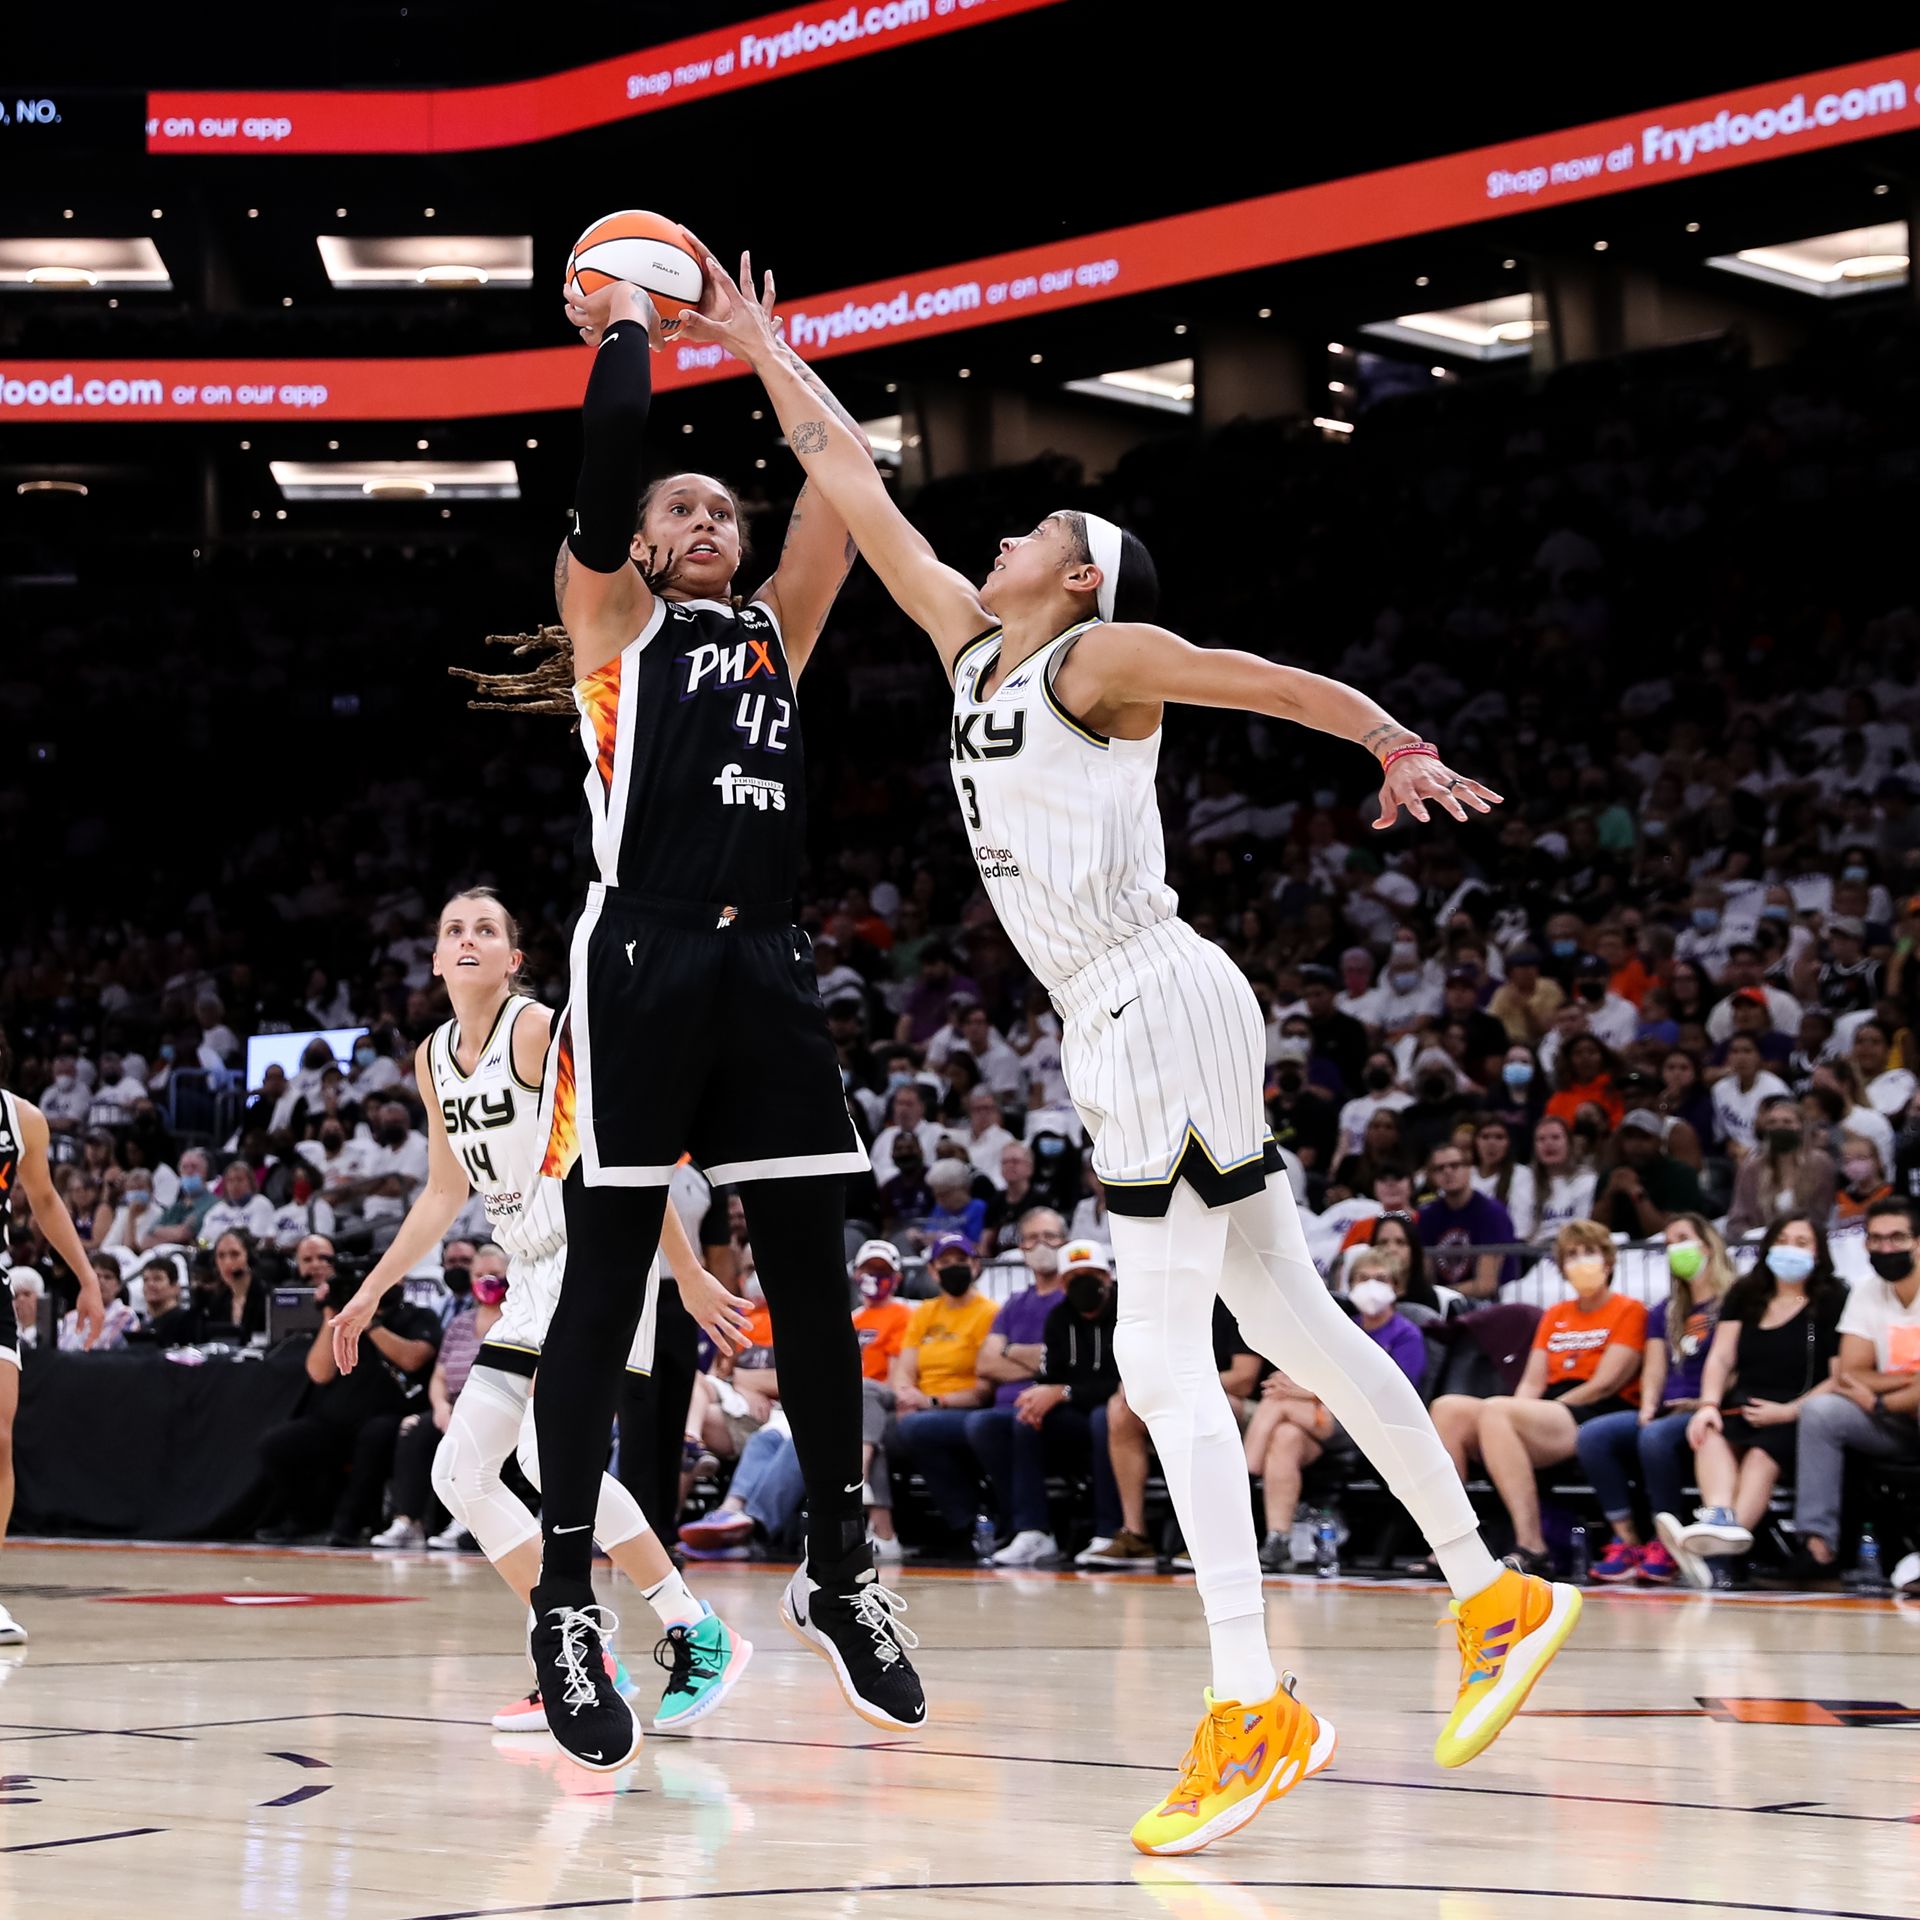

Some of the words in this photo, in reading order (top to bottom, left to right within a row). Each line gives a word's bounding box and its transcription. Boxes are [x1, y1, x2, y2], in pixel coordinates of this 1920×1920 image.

[627, 71, 671, 99] Shop
[674, 62, 714, 87] now
[715, 51, 734, 75] at
[739, 0, 930, 69] Frysfood.com
[16, 99, 62, 124] NO.
[146, 117, 160, 137] r
[163, 117, 195, 138] on
[199, 117, 238, 138] our
[242, 117, 292, 141] app
[1486, 165, 1548, 198] Shop
[1551, 154, 1604, 185] now
[1606, 143, 1635, 171] at
[1641, 79, 1907, 165] Frysfood.com
[677, 344, 721, 371] Shop
[790, 282, 981, 347] Frysfood.com
[985, 284, 1006, 305] or
[1010, 276, 1037, 301] on
[1039, 269, 1073, 294] our
[1075, 258, 1119, 288] app
[171, 385, 198, 405] or
[200, 385, 232, 405] on
[236, 385, 275, 405] our
[279, 385, 328, 408] app
[684, 639, 777, 694] PHX
[735, 692, 791, 750] 42
[951, 709, 1027, 763] KY
[960, 776, 981, 830] 3
[442, 1087, 516, 1134] SKY
[462, 1141, 498, 1182] 14
